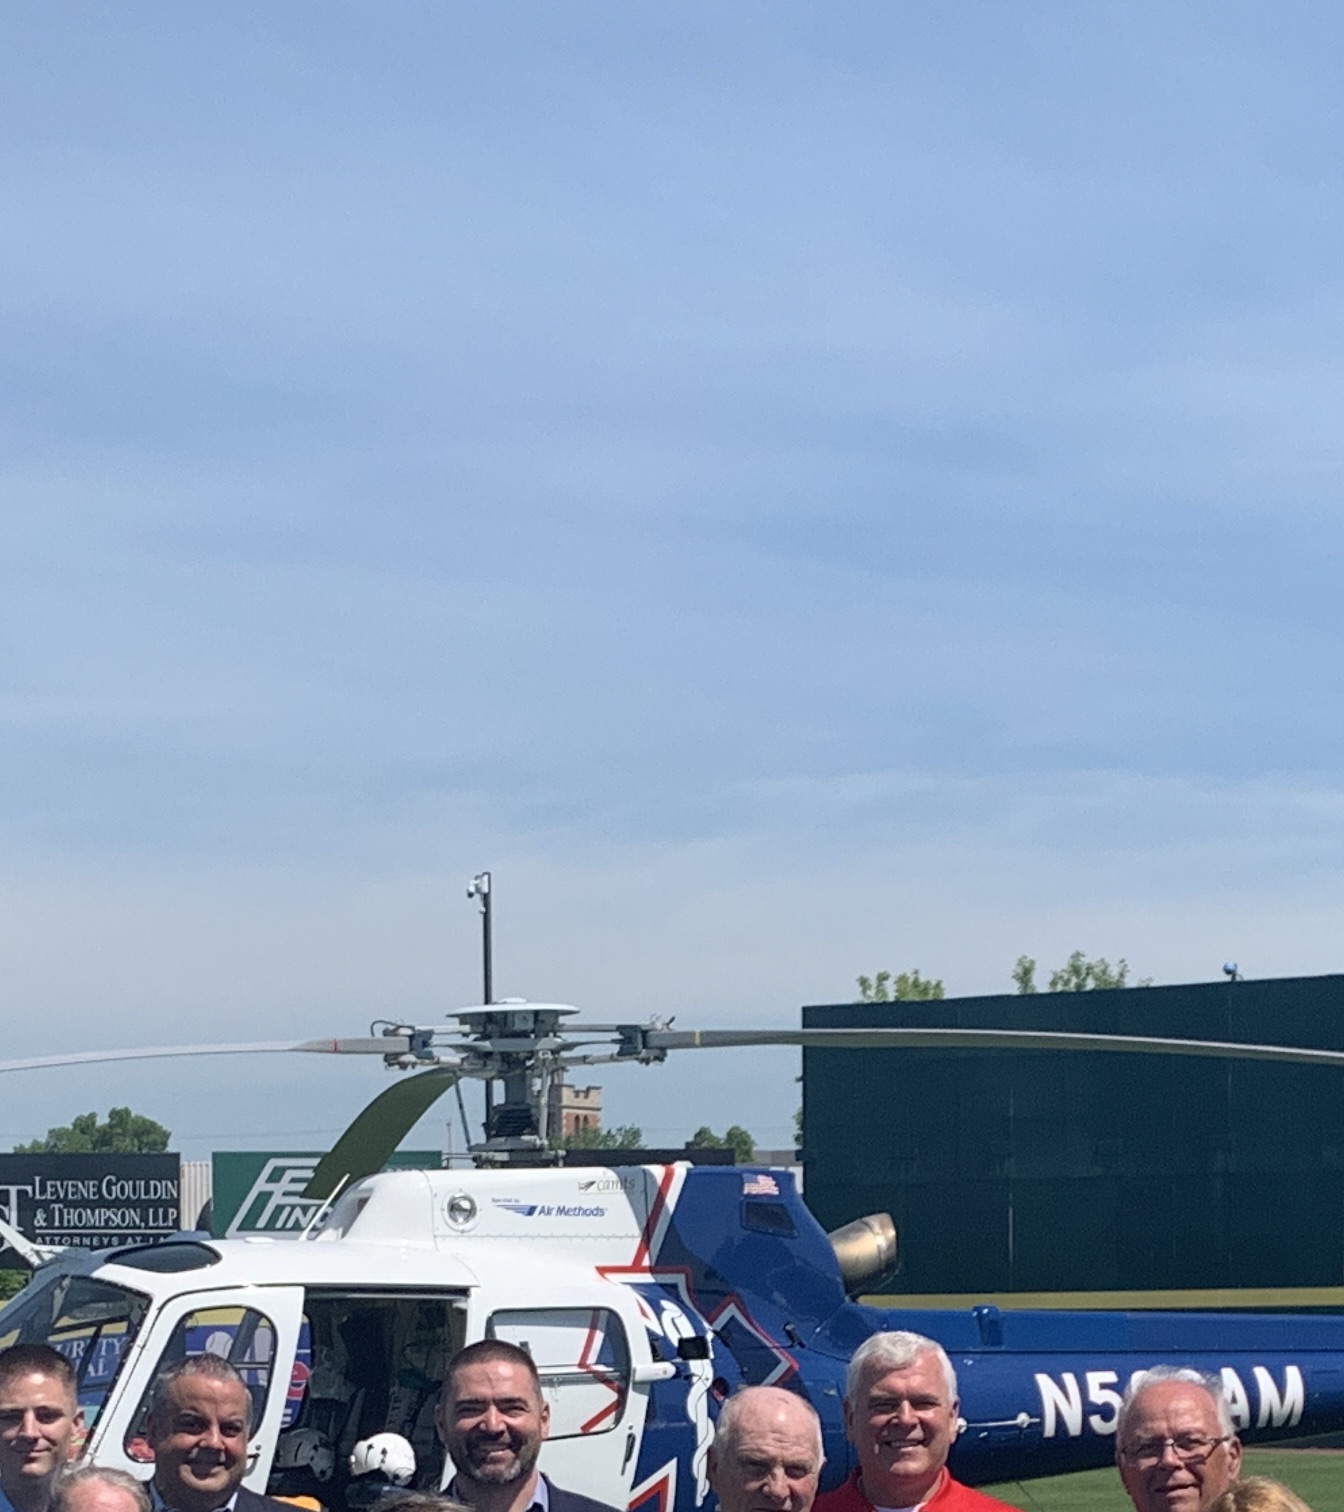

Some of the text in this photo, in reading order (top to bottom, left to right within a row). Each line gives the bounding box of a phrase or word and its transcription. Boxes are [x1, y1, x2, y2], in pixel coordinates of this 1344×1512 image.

[34, 1174, 179, 1200] LEVENE GOULDIN
[33, 1203, 178, 1230] & THOMPSON, LLP
[537, 1204, 606, 1217] Air Methods
[35, 1236, 168, 1247] ATTORNEYS AT LA
[1034, 1364, 1306, 1438] N5AM
